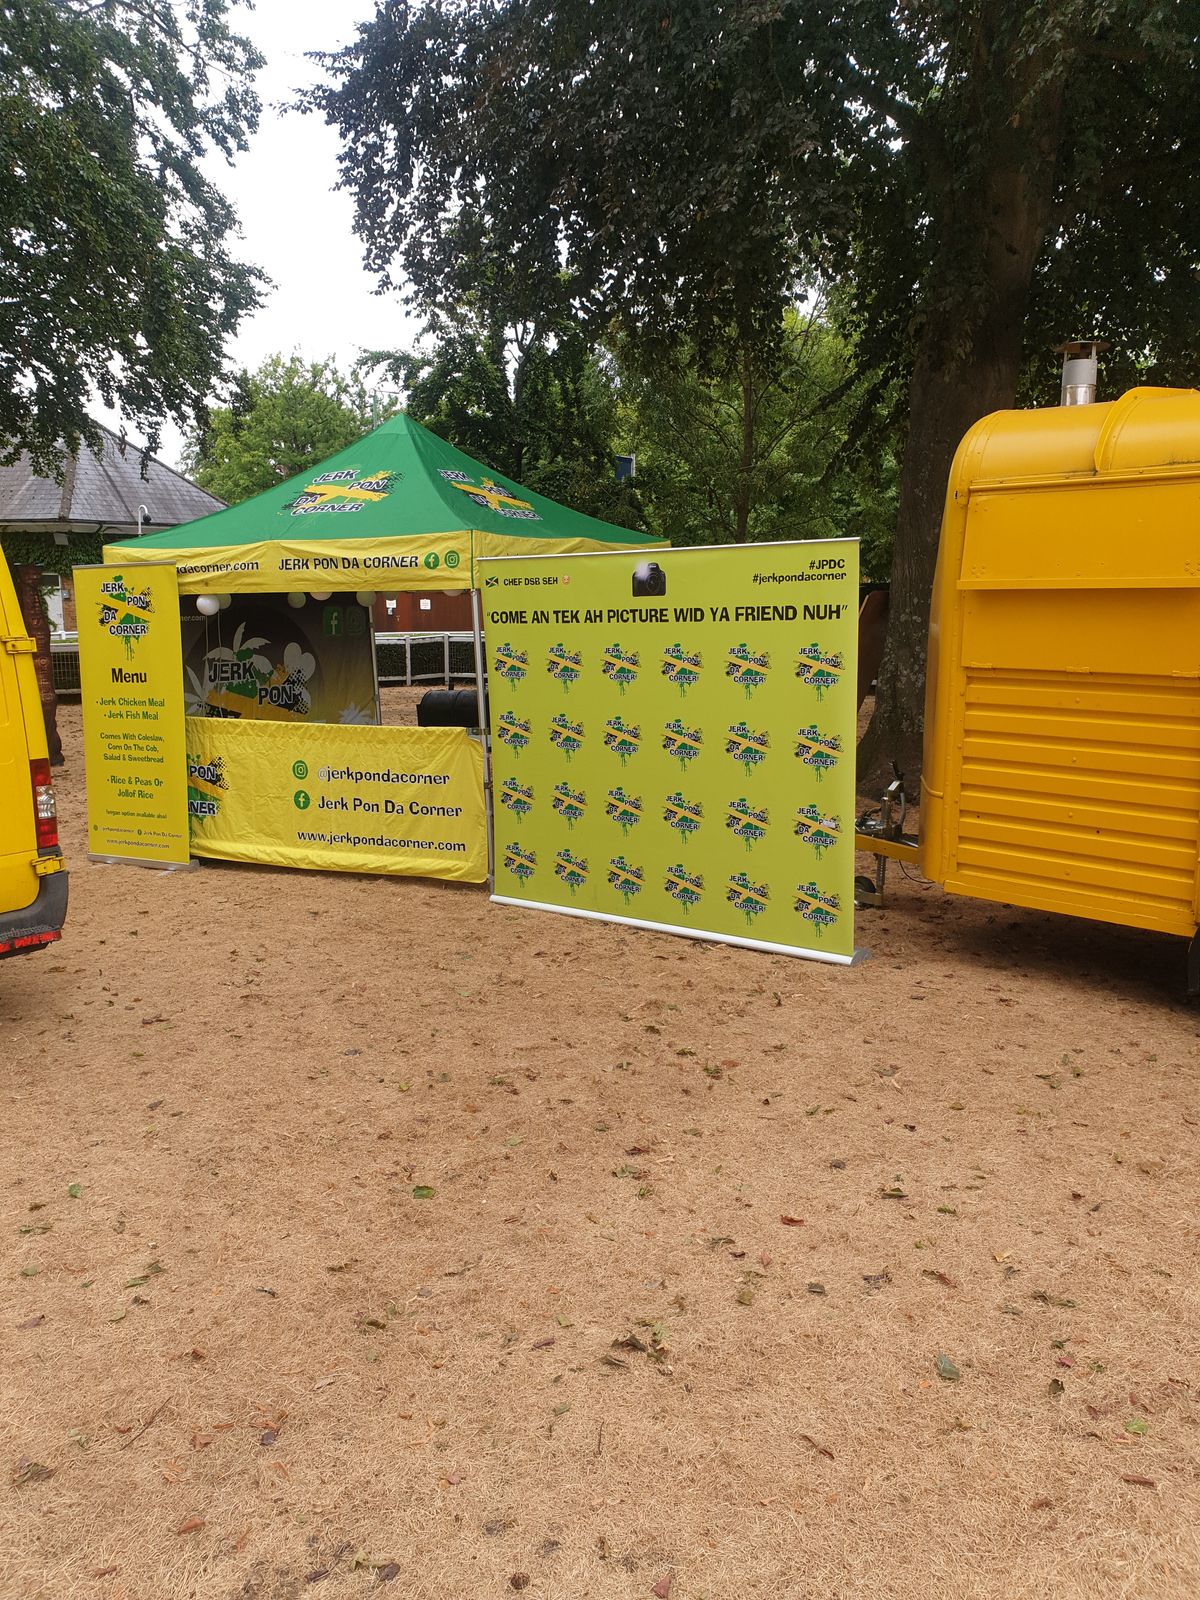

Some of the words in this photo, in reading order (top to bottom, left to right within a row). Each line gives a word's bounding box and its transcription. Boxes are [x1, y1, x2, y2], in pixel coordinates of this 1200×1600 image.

[313, 470, 359, 483] JERK
[348, 480, 386, 490] PON
[294, 496, 319, 505] DA
[292, 504, 363, 515] CORNER
[279, 559, 309, 570] JERK
[314, 558, 338, 569] PON
[342, 558, 359, 569] DA
[364, 556, 418, 568] CORNER
[809, 559, 845, 570] #JPDC
[503, 578, 522, 586] CHEF
[525, 577, 541, 585] DSB
[542, 577, 558, 585] SEH
[753, 572, 846, 585] #jerkpondacorner
[101, 583, 124, 593] JERK
[127, 597, 145, 606] PON
[104, 612, 117, 620] DA
[532, 610, 549, 623] AN
[553, 610, 580, 623] TEK
[584, 610, 603, 623] AH
[608, 608, 669, 623] PICTURE
[674, 607, 704, 622] WID
[710, 607, 730, 622] YA
[735, 606, 797, 621] FRIEND
[109, 625, 146, 635] CORNER
[112, 668, 147, 683] Menu
[208, 662, 254, 682] JERK
[258, 686, 293, 704] PON
[100, 698, 116, 706] Jerk
[118, 698, 146, 706] Chicken
[148, 699, 165, 707] Meal
[108, 711, 124, 719] Jerk
[126, 711, 140, 719] Fish
[142, 711, 159, 720] Meal
[137, 734, 165, 742] Coleslaw,
[146, 745, 159, 753] Cob,
[128, 755, 164, 763] Sweetbread
[803, 758, 835, 766] CORNER
[190, 766, 215, 778] PON
[318, 766, 450, 785] @jerkpondacorner
[111, 776, 126, 784] Rice
[128, 777, 133, 785] &
[135, 777, 152, 786] Peas
[154, 778, 163, 787] Or
[118, 789, 136, 797] Jollof
[137, 790, 154, 799] Rice
[318, 796, 348, 810] Jerk
[353, 798, 379, 812] Pon
[384, 800, 404, 814] Da
[409, 802, 462, 817] Corner
[734, 829, 763, 837] CORNER
[298, 832, 466, 851] www.jerkpondacorner.com
[803, 836, 834, 845] CORNER
[614, 884, 640, 892] CORNER
[797, 885, 817, 893] JERK
[672, 892, 699, 901] CORNER
[819, 897, 835, 905] PON
[735, 902, 763, 912] CORNER
[803, 913, 834, 922] CORNER
